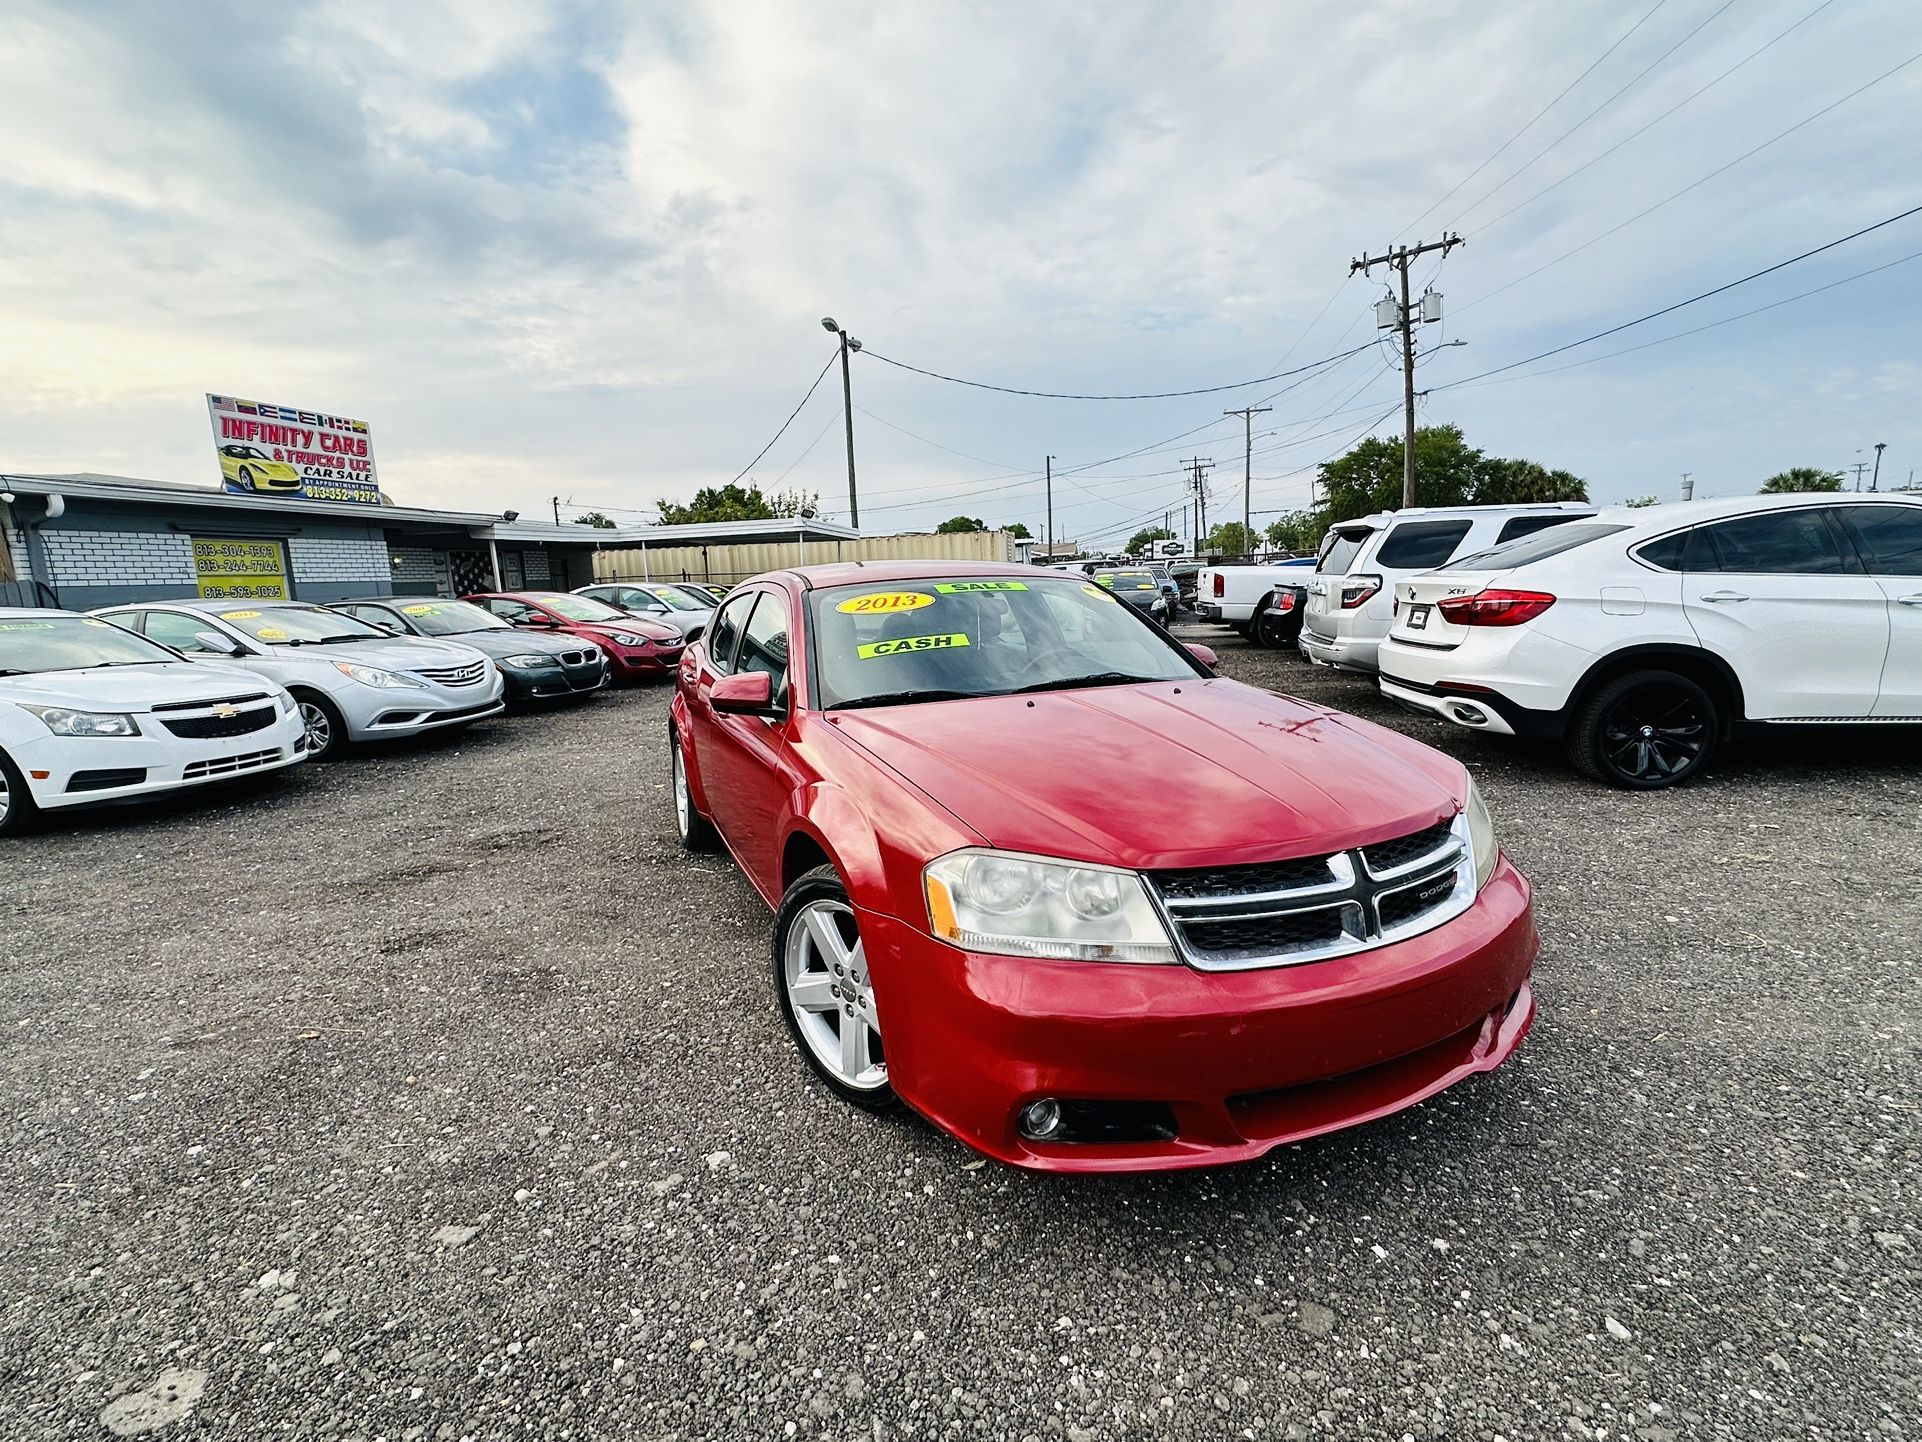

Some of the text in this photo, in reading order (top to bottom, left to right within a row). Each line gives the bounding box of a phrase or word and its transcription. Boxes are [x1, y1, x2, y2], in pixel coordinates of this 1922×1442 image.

[220, 416, 368, 457] INFINITY CARS
[273, 448, 285, 462] &
[285, 449, 346, 470] TRUCKS
[303, 466, 374, 483] CAR SALE
[304, 478, 314, 486] BY
[315, 480, 360, 490] APPOINTMENT
[195, 544, 275, 557] 813-304-1393
[198, 559, 280, 572] 813-244-7744
[204, 586, 282, 599] 813-593-1025
[950, 582, 1012, 591] SALE
[854, 594, 919, 612] 2013
[873, 636, 952, 655] CASH
